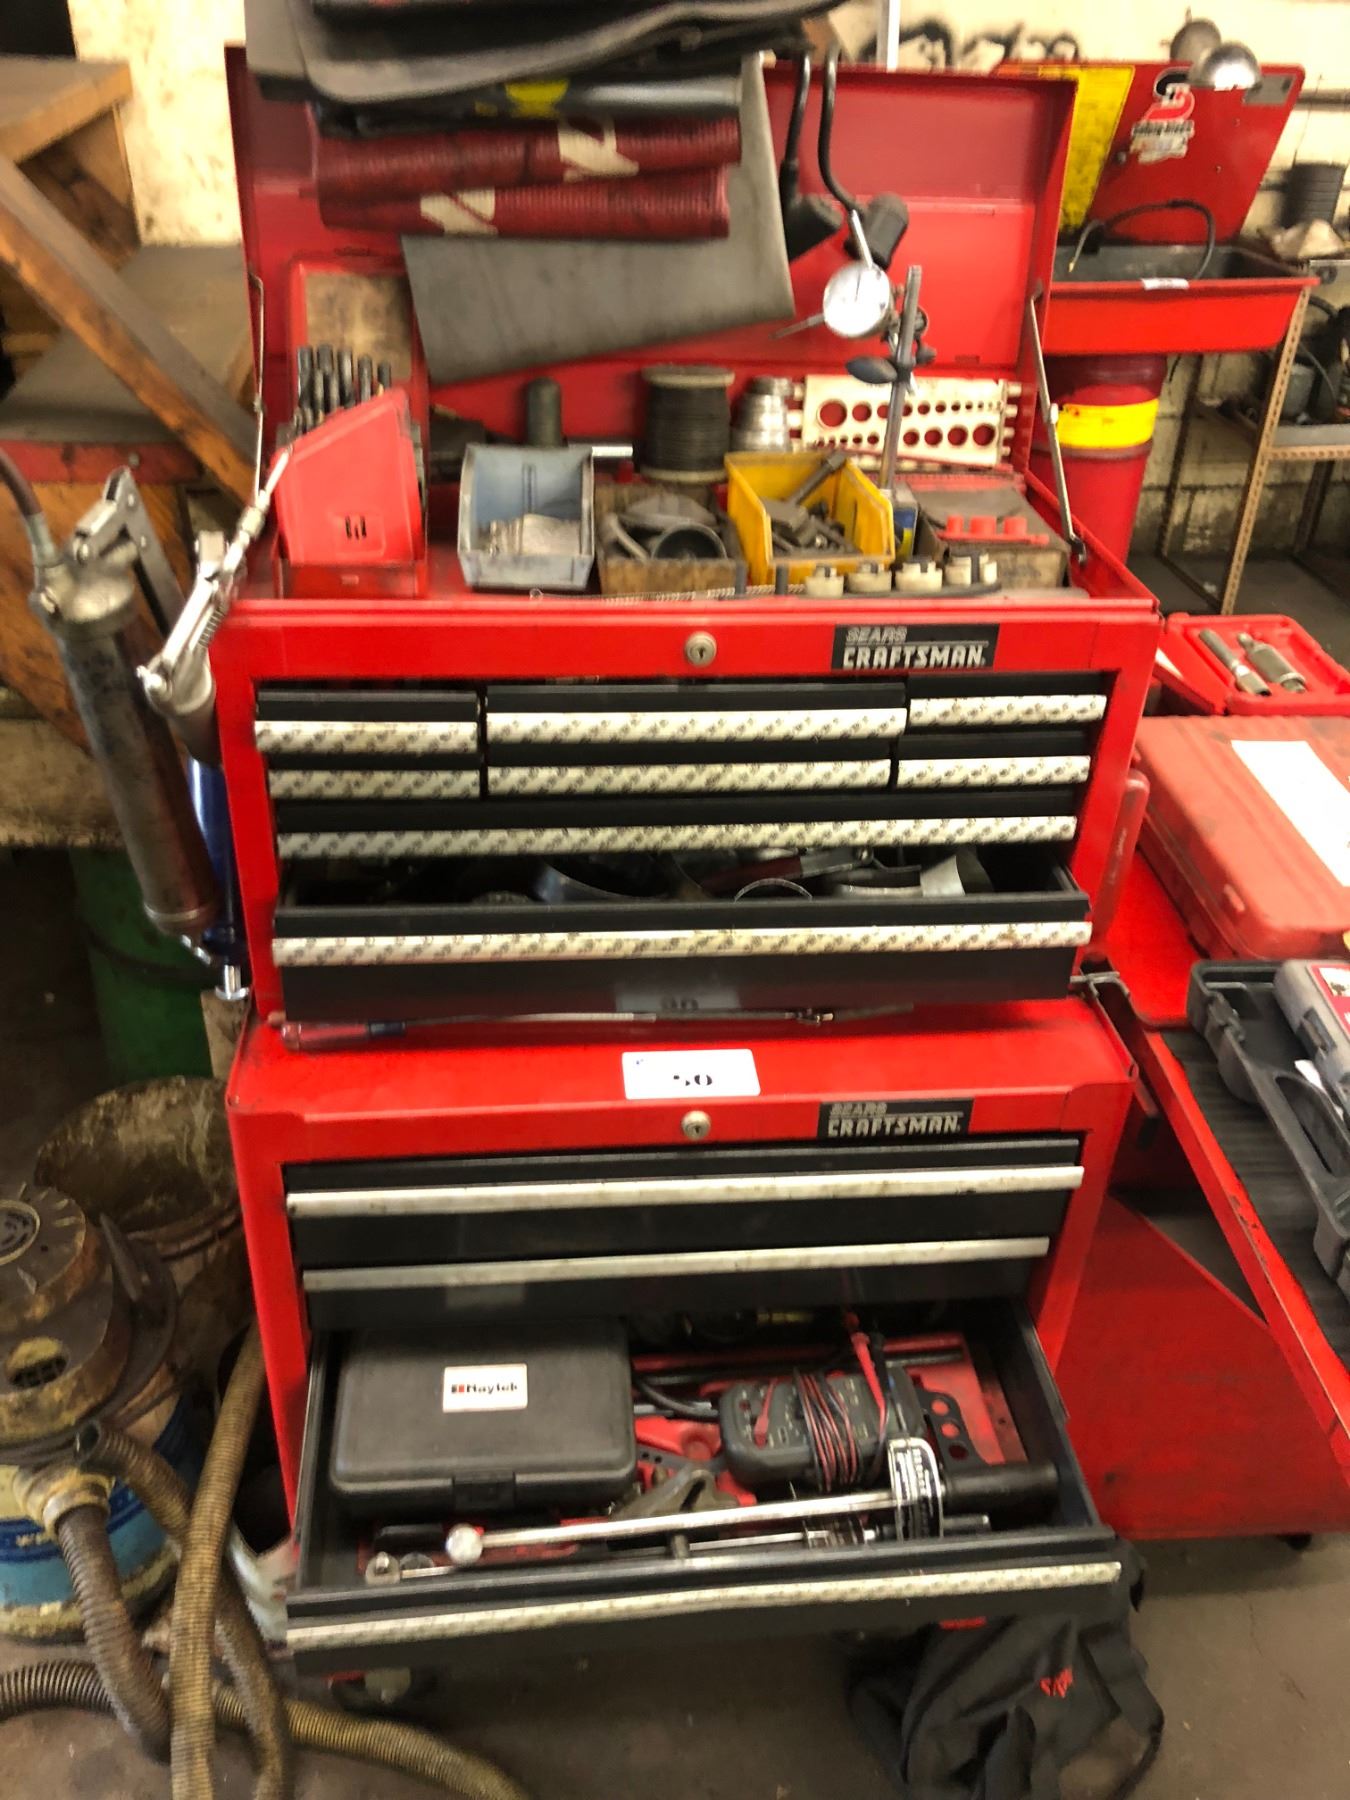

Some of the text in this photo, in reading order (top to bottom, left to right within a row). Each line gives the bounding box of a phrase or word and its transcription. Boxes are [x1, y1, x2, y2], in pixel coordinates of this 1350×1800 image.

[846, 626, 908, 644] SEARS
[842, 644, 984, 671] CRAFTSMAN
[827, 1115, 960, 1138] CRAFTSMAN
